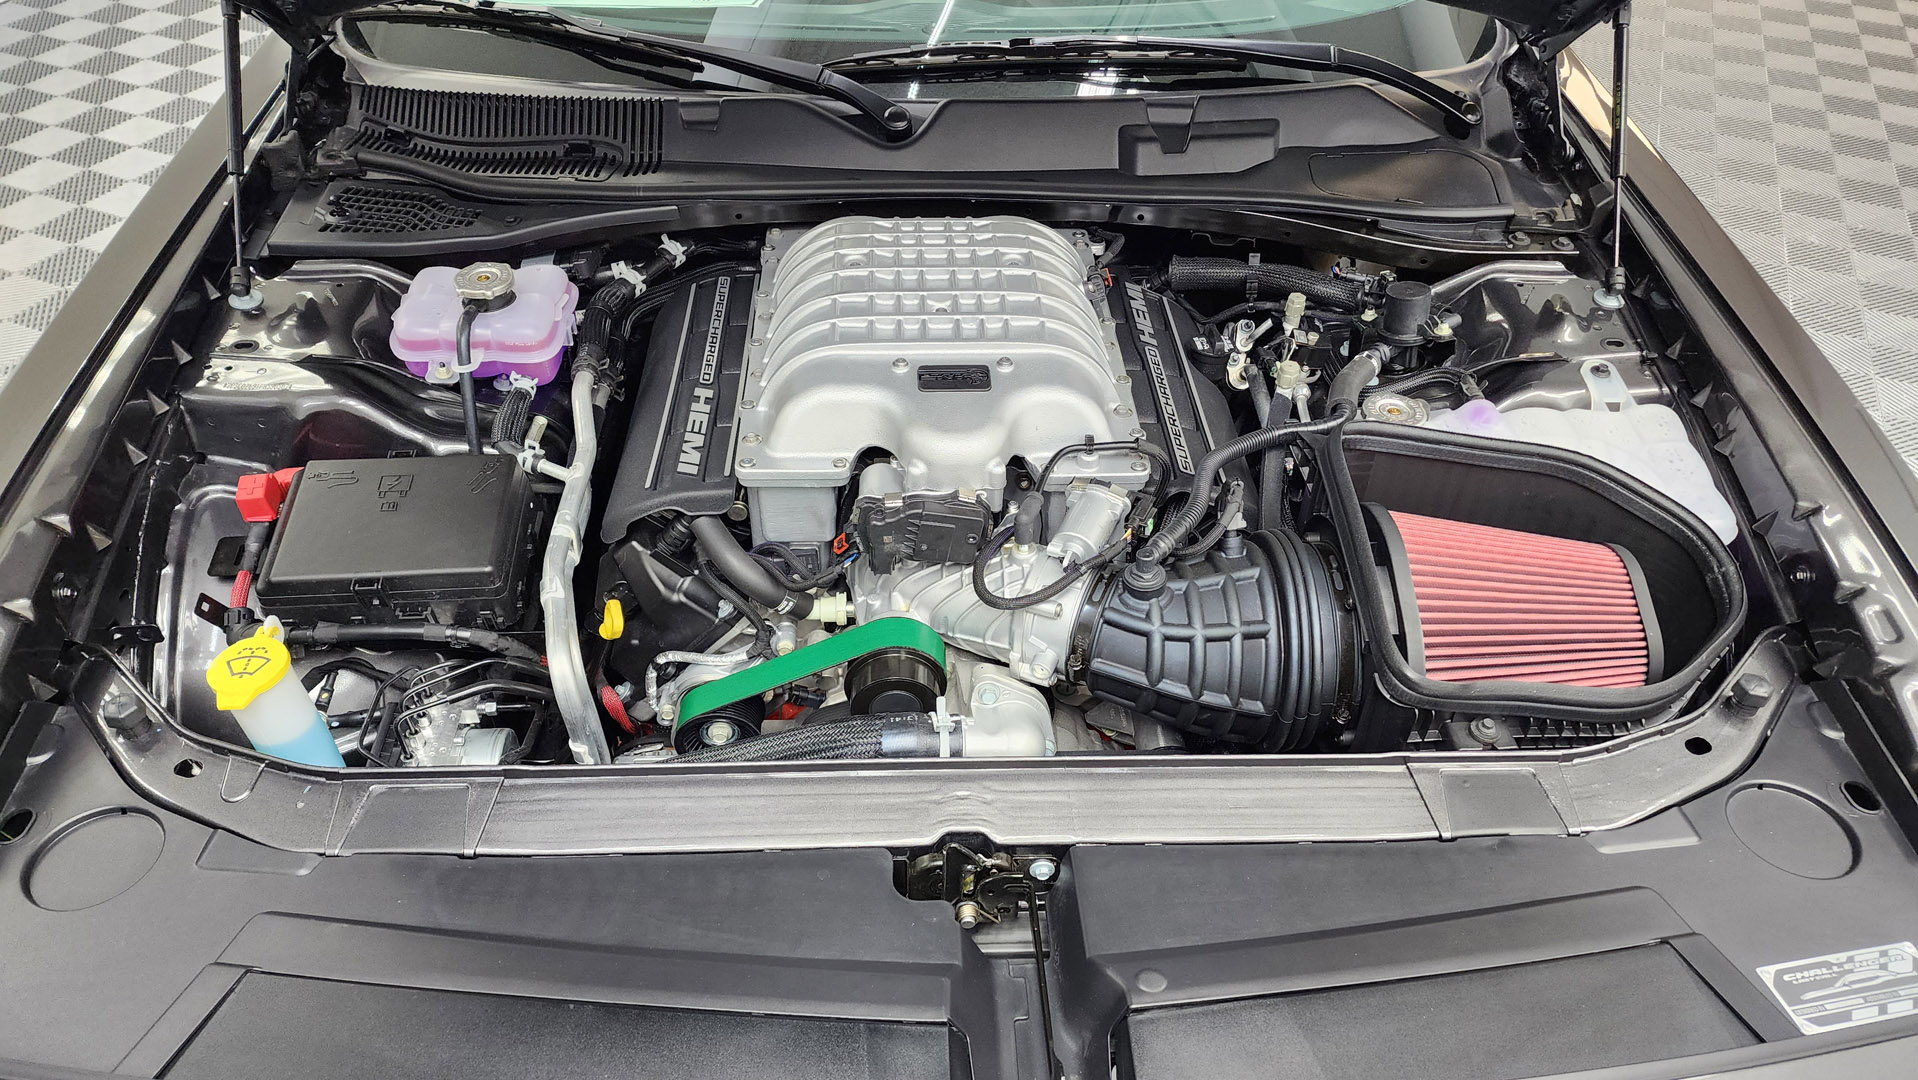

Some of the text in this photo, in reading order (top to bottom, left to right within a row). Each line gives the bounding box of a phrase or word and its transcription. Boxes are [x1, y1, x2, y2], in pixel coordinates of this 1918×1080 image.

[677, 278, 729, 475] SUPERCHARGED HEMI
[1125, 281, 1193, 474] SUPERCHARGED HEMI
[1782, 954, 1907, 982] CHALLENGER
